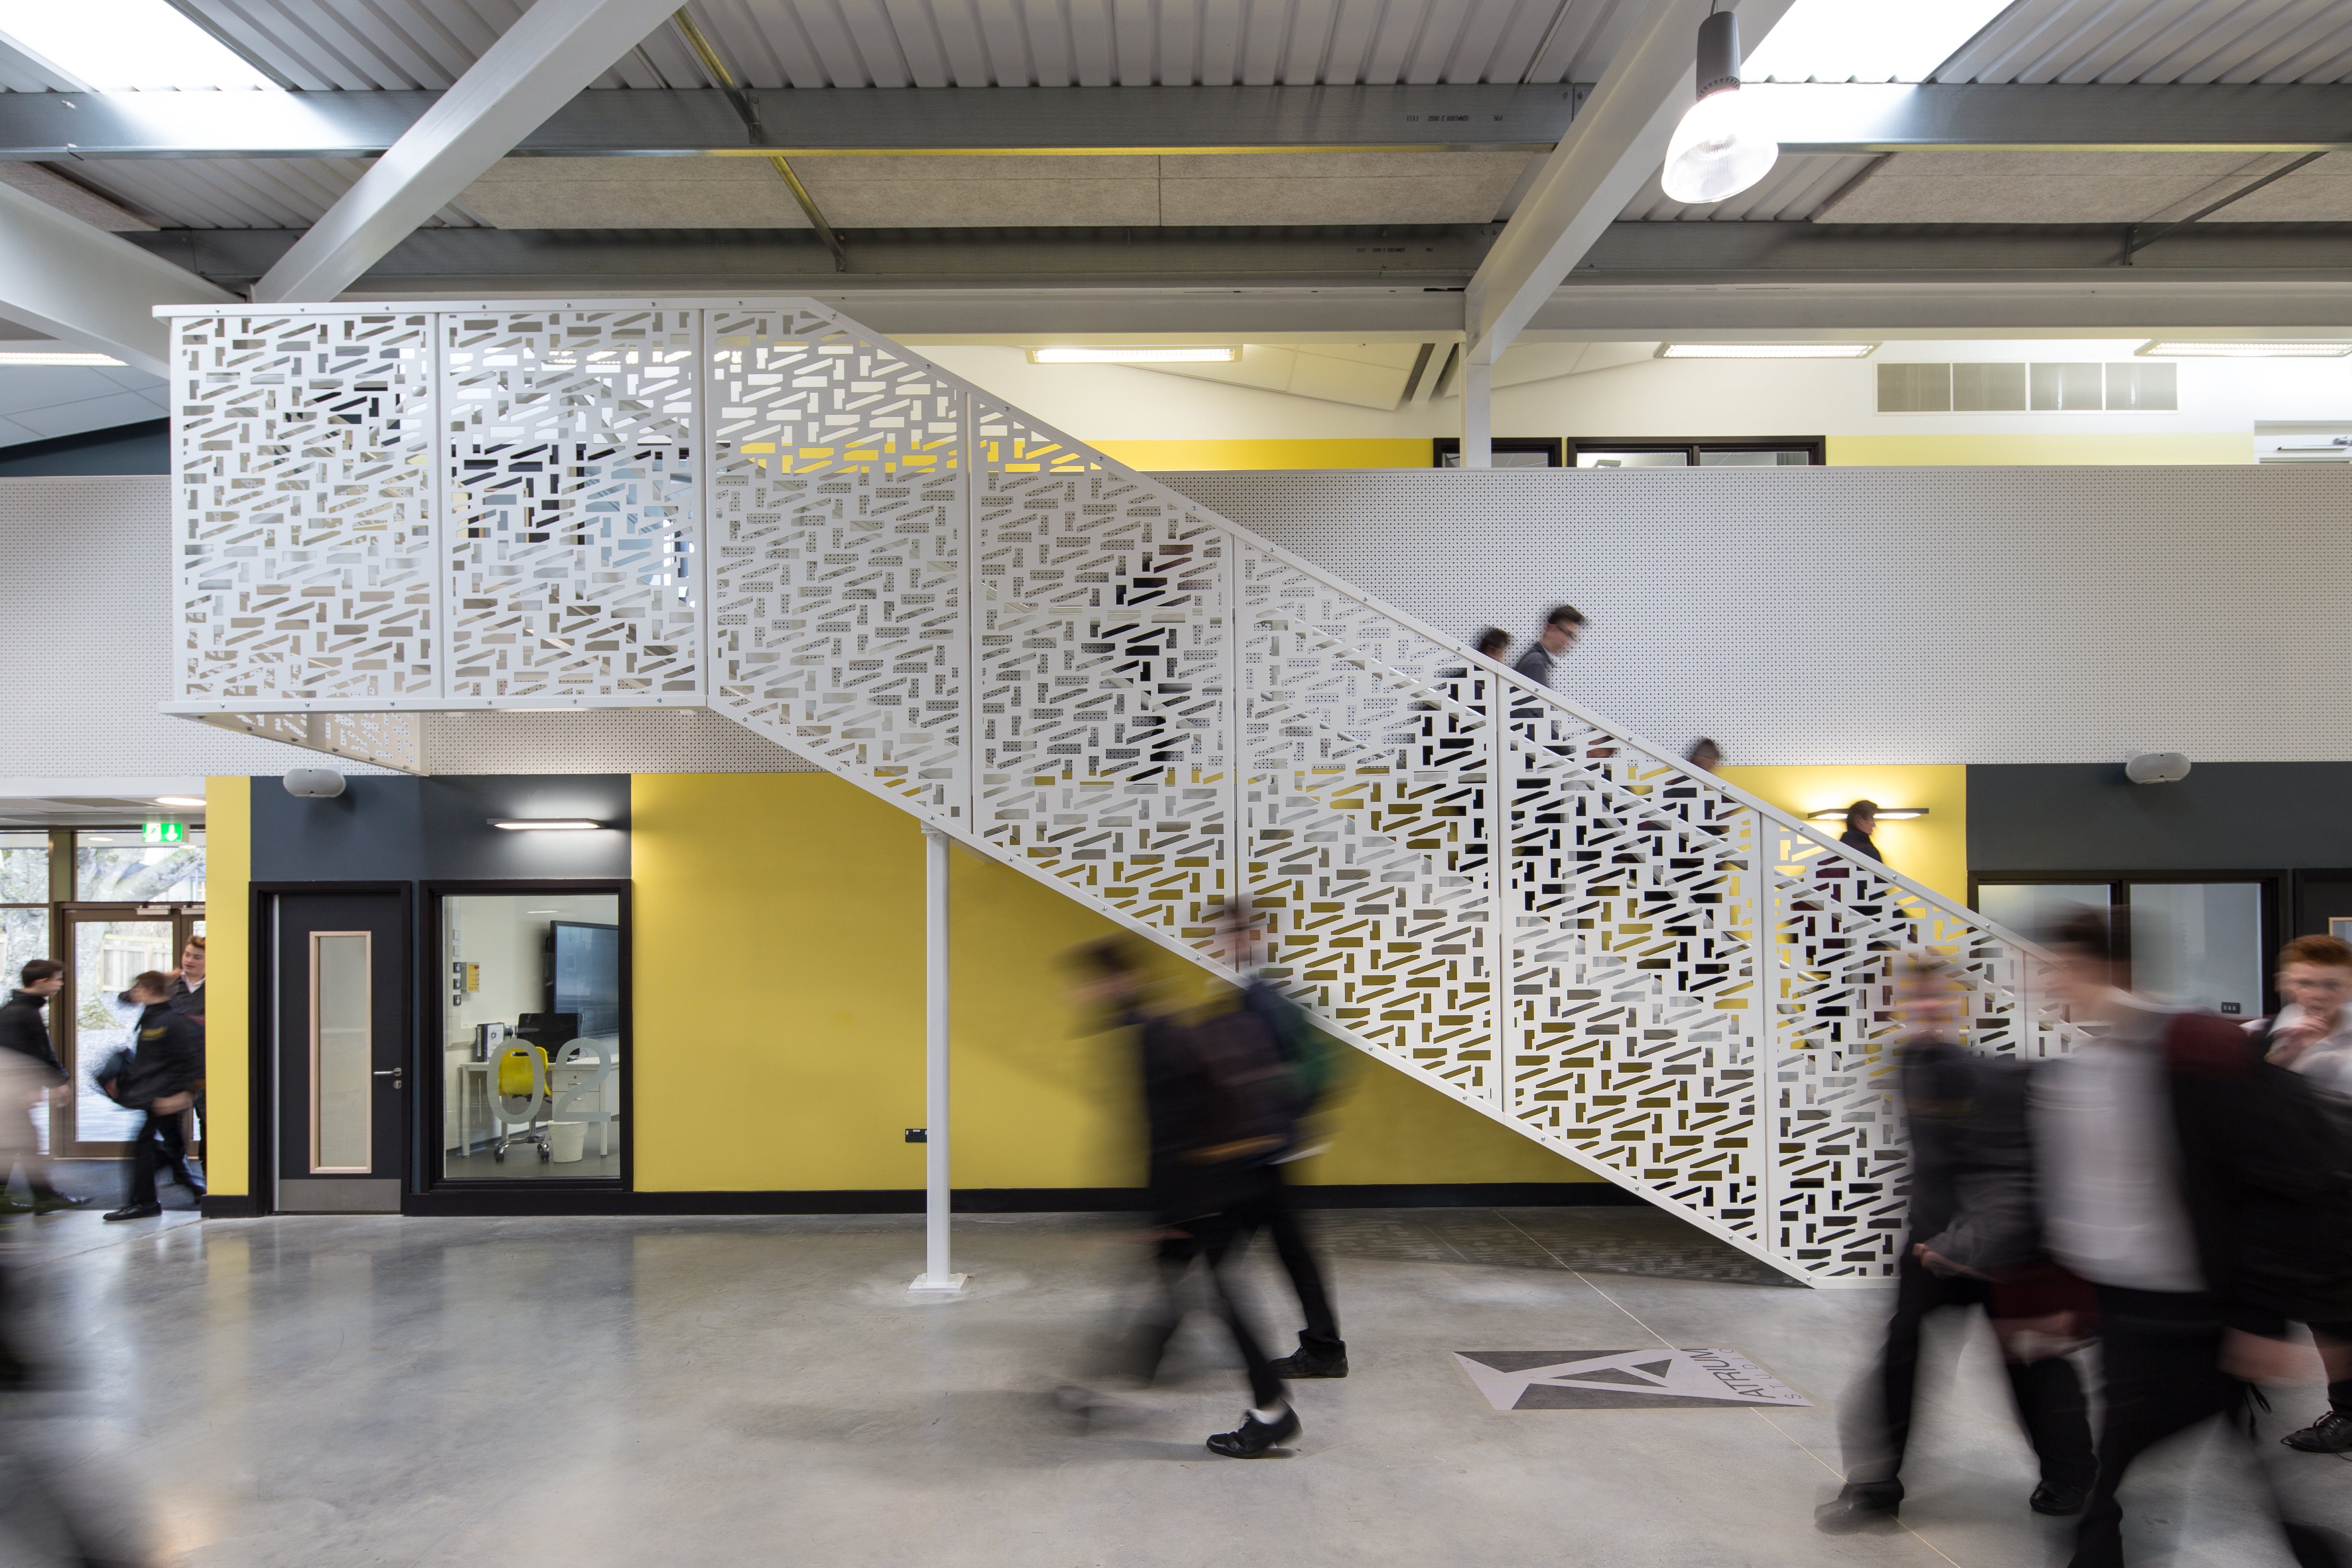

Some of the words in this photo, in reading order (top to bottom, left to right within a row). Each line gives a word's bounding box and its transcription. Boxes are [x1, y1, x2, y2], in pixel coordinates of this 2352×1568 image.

[486, 1038, 611, 1124] 02
[1680, 1348, 1777, 1399] ATRIUM
[1719, 1348, 1801, 1399] STUDIO
